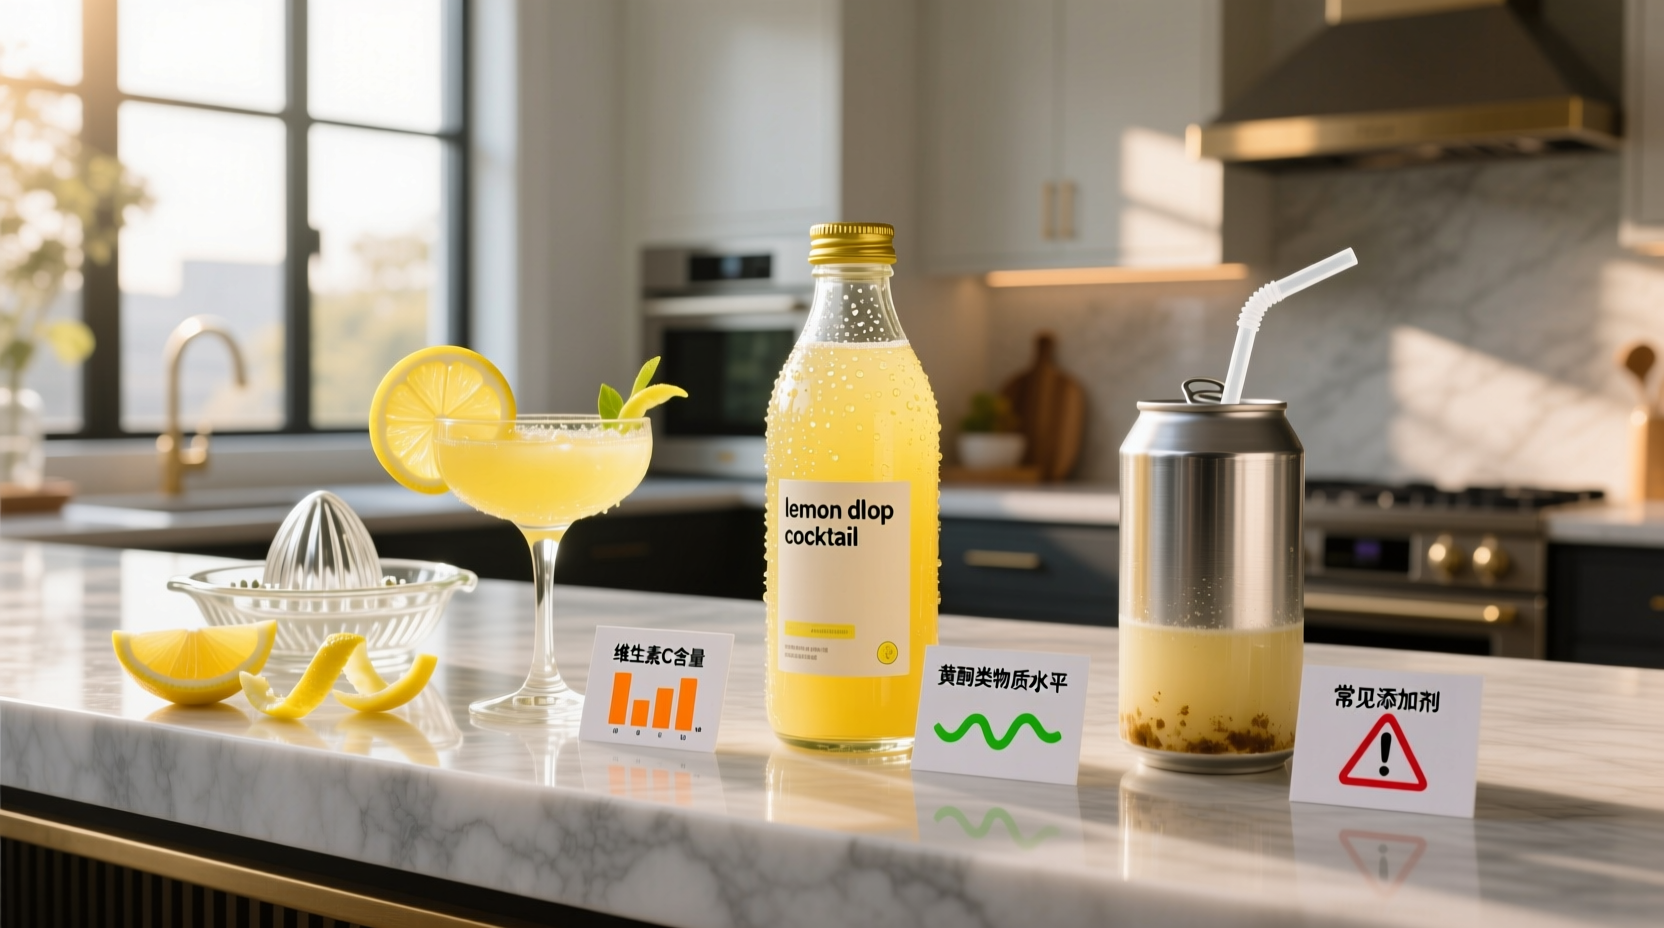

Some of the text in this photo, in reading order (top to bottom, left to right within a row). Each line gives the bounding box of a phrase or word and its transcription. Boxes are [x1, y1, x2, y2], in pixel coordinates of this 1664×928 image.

[785, 496, 842, 520] lemon
[784, 526, 858, 547] cocktail
[613, 643, 705, 668] 维生素C含量
[1334, 684, 1440, 713] 常见添加剂
